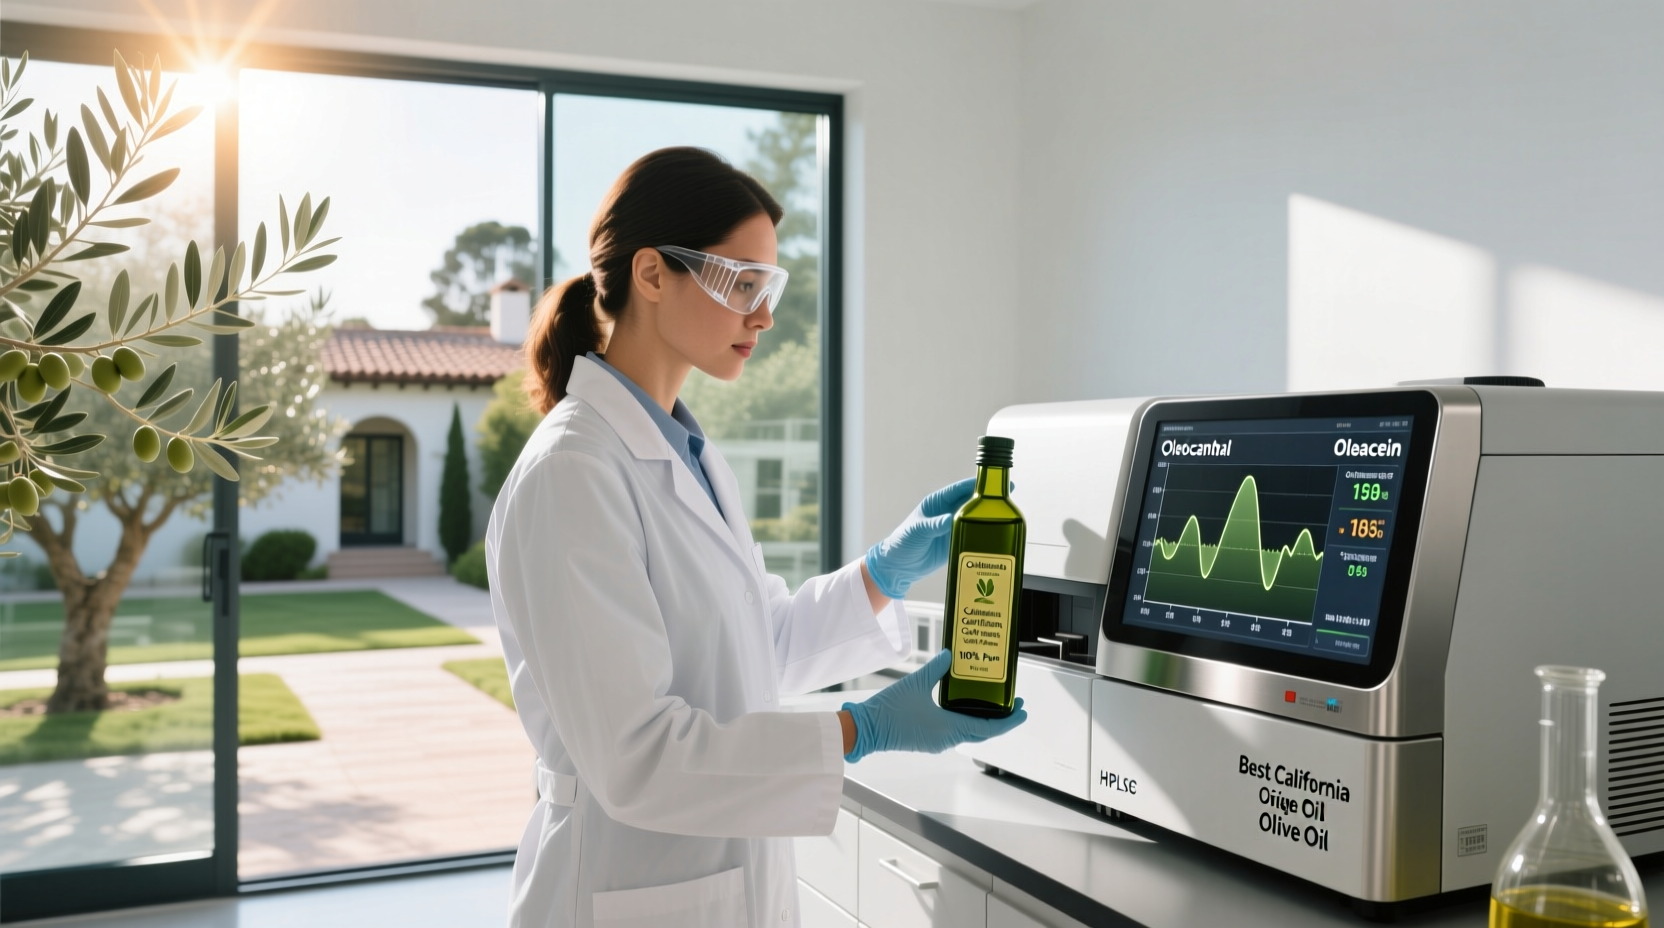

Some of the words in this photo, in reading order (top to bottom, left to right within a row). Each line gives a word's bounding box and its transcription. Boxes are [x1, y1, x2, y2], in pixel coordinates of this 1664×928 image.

[1334, 438, 1402, 457] Oleacein
[1239, 754, 1271, 781] Best
[1275, 764, 1350, 803] California
[1302, 798, 1325, 822] Oil
[1259, 812, 1300, 842] Olive
[1304, 825, 1328, 852] Oil
